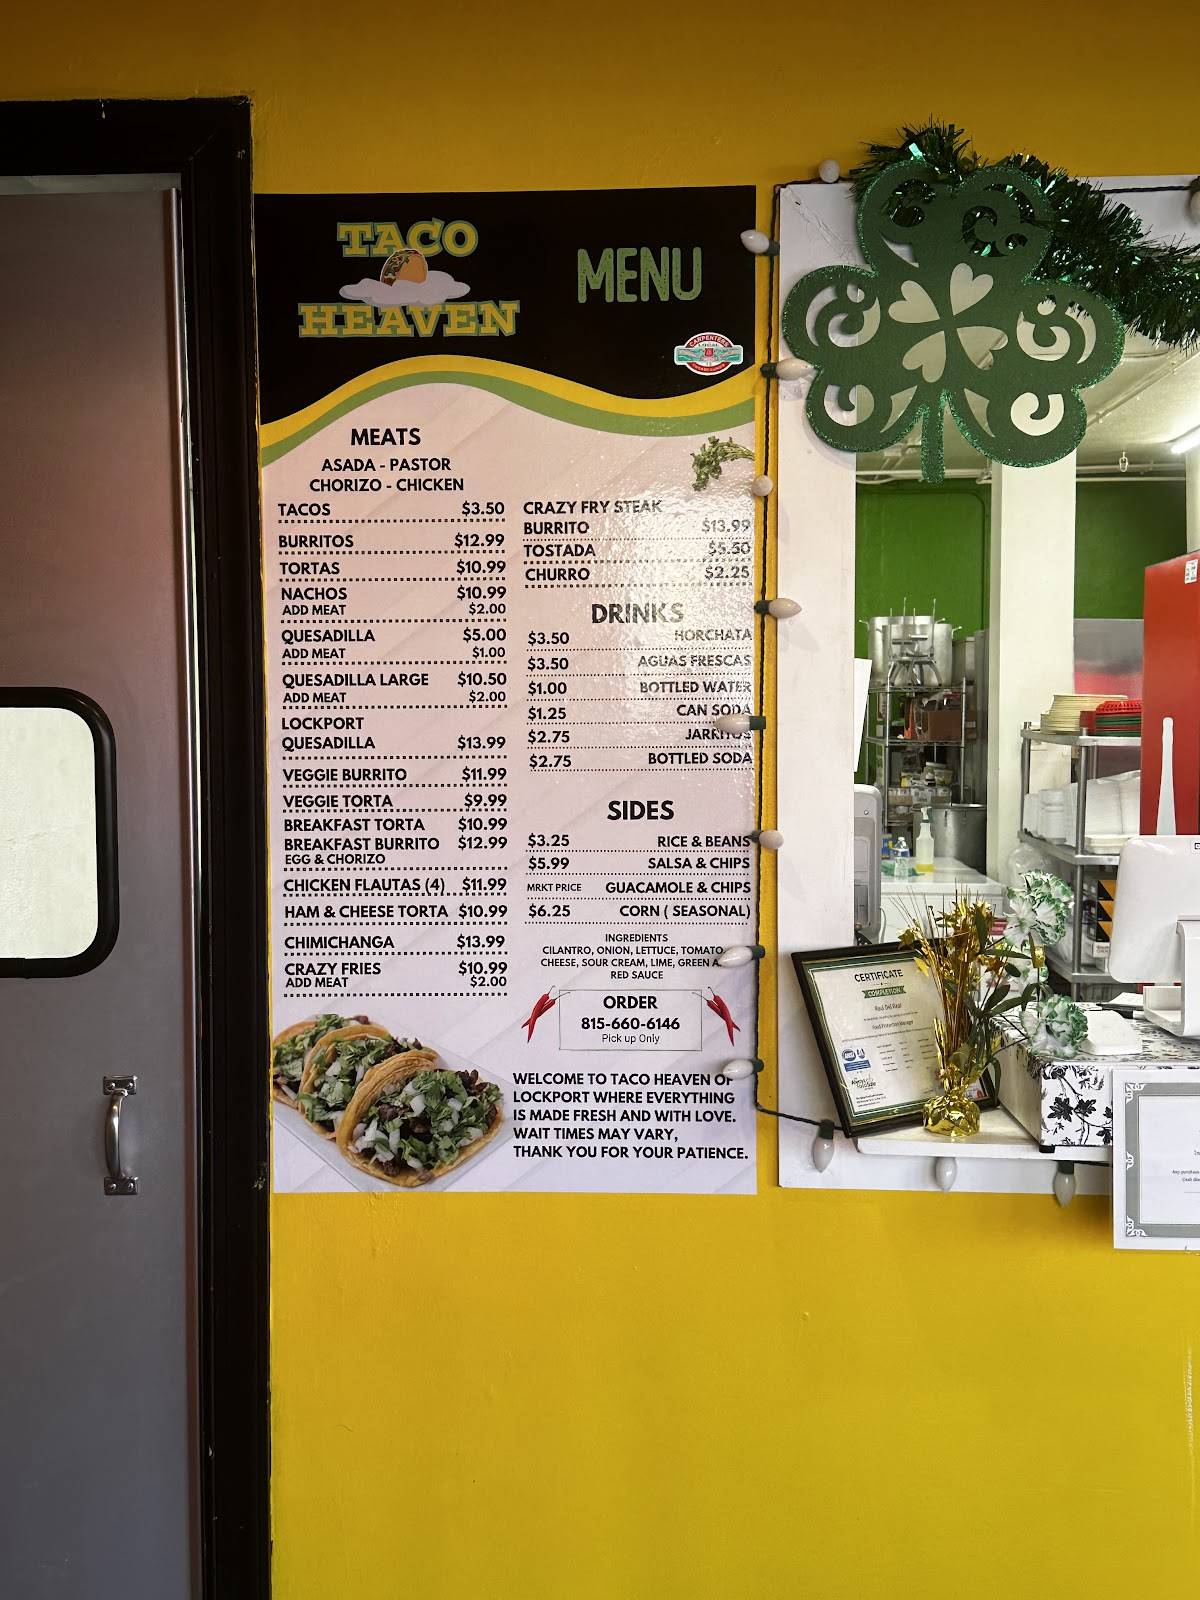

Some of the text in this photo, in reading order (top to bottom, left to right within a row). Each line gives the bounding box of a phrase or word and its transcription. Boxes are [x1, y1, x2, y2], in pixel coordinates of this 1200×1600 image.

[337, 218, 479, 258] TACO
[577, 246, 703, 303] MENU
[298, 300, 520, 338] HEAVEN
[689, 335, 729, 347] CARPENTERS
[351, 428, 421, 445] MEATS
[321, 458, 451, 471] ASADA PASTOR
[310, 478, 463, 492] CHORIZO CHICKEN
[278, 500, 504, 517] TACOS $3.50
[523, 500, 662, 514] CRAZY FRY STEAK
[524, 519, 751, 534] BURRITO $13.99
[279, 532, 504, 548] BURRITOS $12.99
[524, 540, 751, 557] TOSTADA $5.50
[280, 559, 506, 575] TORTAS $10.99
[525, 565, 749, 581] CHURRO $2.25
[282, 585, 506, 601] NACHOS $10.99
[282, 602, 506, 615] ADD MEAT $2.00
[592, 603, 683, 623] DRINKS
[282, 627, 506, 645] QUESADILLA $5.00
[528, 629, 752, 646] $3.50 HORCHATA
[282, 646, 505, 659] ADD MEAT $1.00
[528, 655, 751, 672] $3.50 AGUAS FRESCAS
[282, 671, 507, 689] QUESADILLA LARGE $10.50
[528, 681, 751, 696] $1.00 BOTTLED WATER
[283, 690, 506, 703] ADD MEAT $2.00
[528, 704, 752, 721] $1.25 CAN SODA
[282, 717, 364, 730] LOCKPORT
[282, 735, 506, 752] QUESADILLA $13.99
[528, 729, 569, 745] $2.75
[529, 752, 752, 769] $2.75 BOTTLED SODA
[283, 766, 507, 782] VEGGIE BURRITO $11.99
[283, 792, 507, 808] VEGGIE TORTA $9.99
[607, 800, 674, 820] SIDES
[284, 816, 507, 832] BREAKFAST TORTA $10.99
[285, 835, 507, 851] BREAKFAST BURRITO $12.99
[528, 833, 750, 848] $3.25 RICE BEANS
[285, 854, 385, 864] EGG CHORIZO
[529, 856, 750, 871] $5.99 SALSA CHIPS
[284, 876, 506, 896] CHICKEN FLAUTAS (4) $11.99
[606, 882, 693, 893] GUACAMOLE
[711, 882, 751, 893] CHIPS
[285, 903, 507, 919] HAM CHEESE TORTA $10.99
[529, 903, 750, 919] $6.25 CORN SEASONAL)
[284, 934, 505, 949] CHIMICHANGA $13.99
[606, 934, 668, 942] INGREDIENTS
[543, 946, 594, 955] CILANTRO,
[597, 946, 633, 955] ONION,
[636, 946, 678, 955] LETTUCE,
[285, 960, 507, 976] CRAZY FRIES $10.99
[541, 958, 578, 968] CHEESE,
[611, 959, 648, 968] CREAM,
[651, 959, 675, 968] LIME,
[678, 959, 709, 967] GREEN
[286, 975, 507, 988] ADD MEAT $2.00
[611, 971, 663, 979] RED SAUCE
[854, 969, 903, 982] CERTIFICATE
[868, 987, 901, 997] COMPLETION
[603, 996, 658, 1009] ORDER
[581, 1017, 680, 1029] 815-660-6146
[602, 1034, 659, 1044] Pick up Only
[513, 1073, 584, 1084] WELCOME
[588, 1073, 607, 1085] TO
[610, 1073, 650, 1085] TACO
[654, 1074, 710, 1085] HEAVEN
[514, 1091, 735, 1104] LOCKPORT WHERE EVERYTHING
[514, 1109, 736, 1122] IS MADE FRESH AND WITH LOVE.
[513, 1127, 678, 1142] WAIT TIMES MAY VARY,
[513, 1146, 748, 1159] THANK YOU FOR YOUR PATIENCE.
